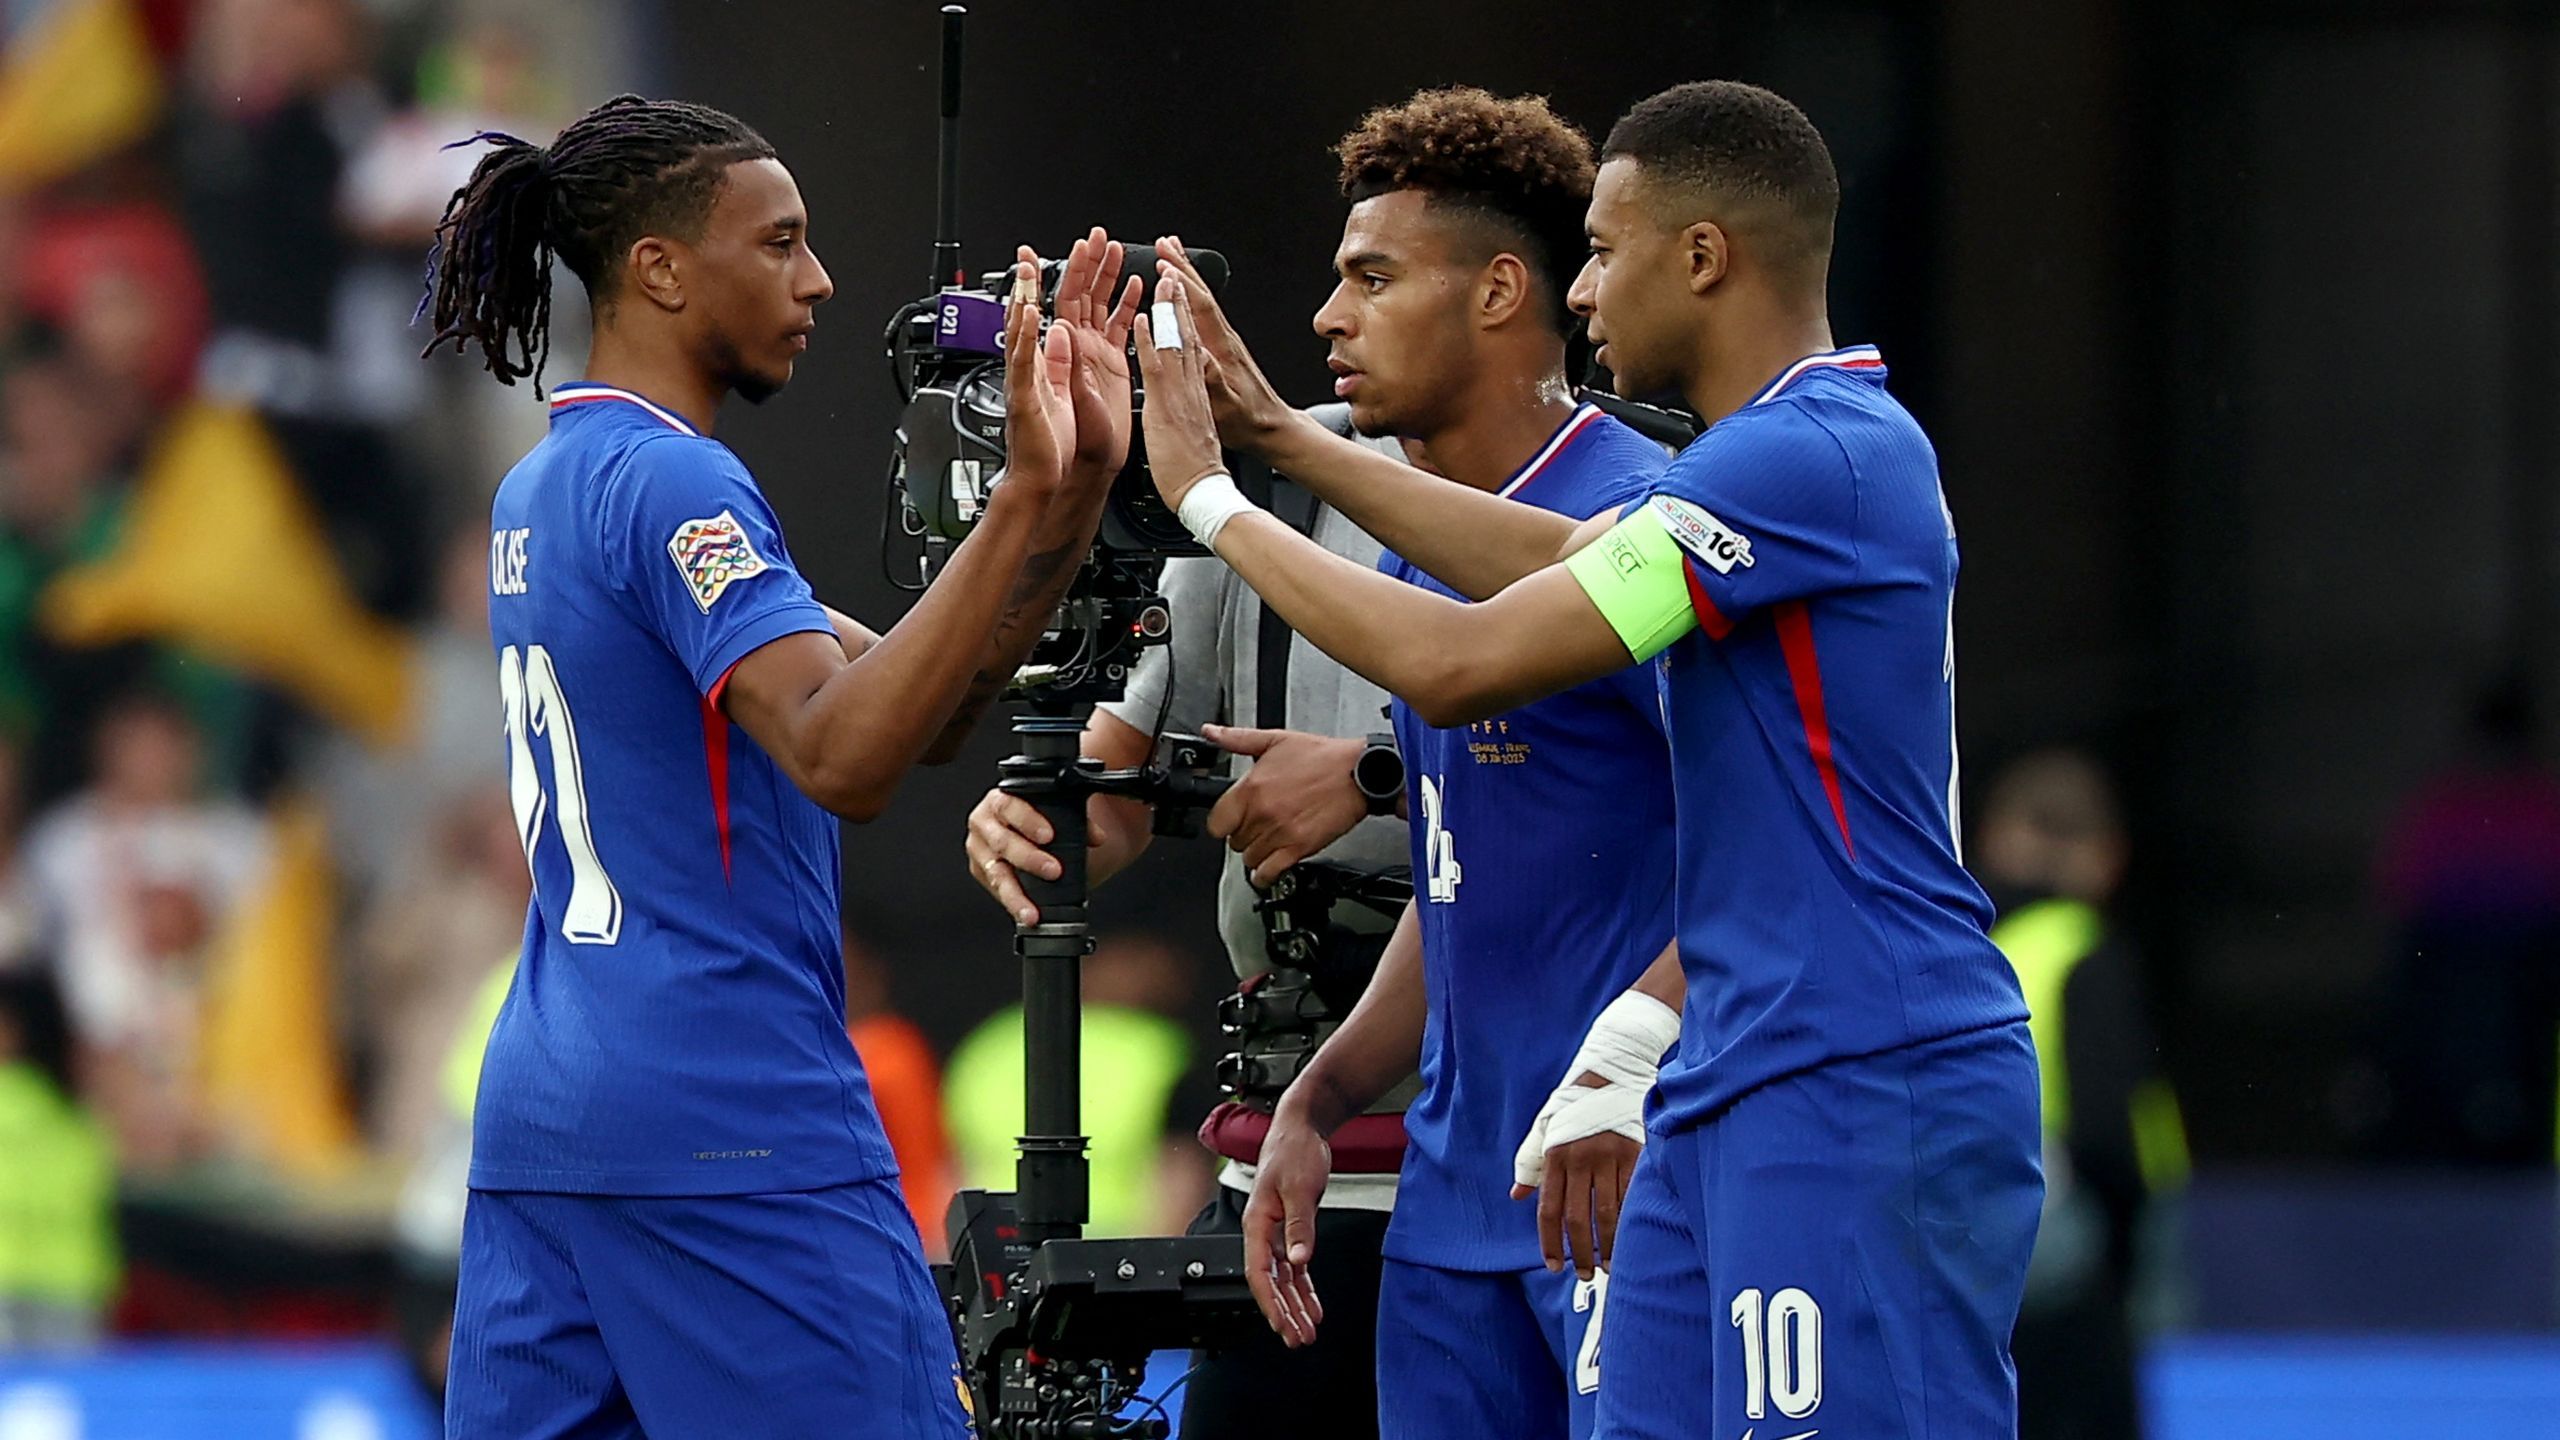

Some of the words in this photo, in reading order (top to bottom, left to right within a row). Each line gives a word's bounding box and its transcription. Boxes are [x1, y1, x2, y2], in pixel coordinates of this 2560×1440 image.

[941, 304, 959, 335] 021
[492, 527, 530, 596] OLISE
[1573, 1266, 1610, 1395] 2
[1731, 1287, 1822, 1419] 10
